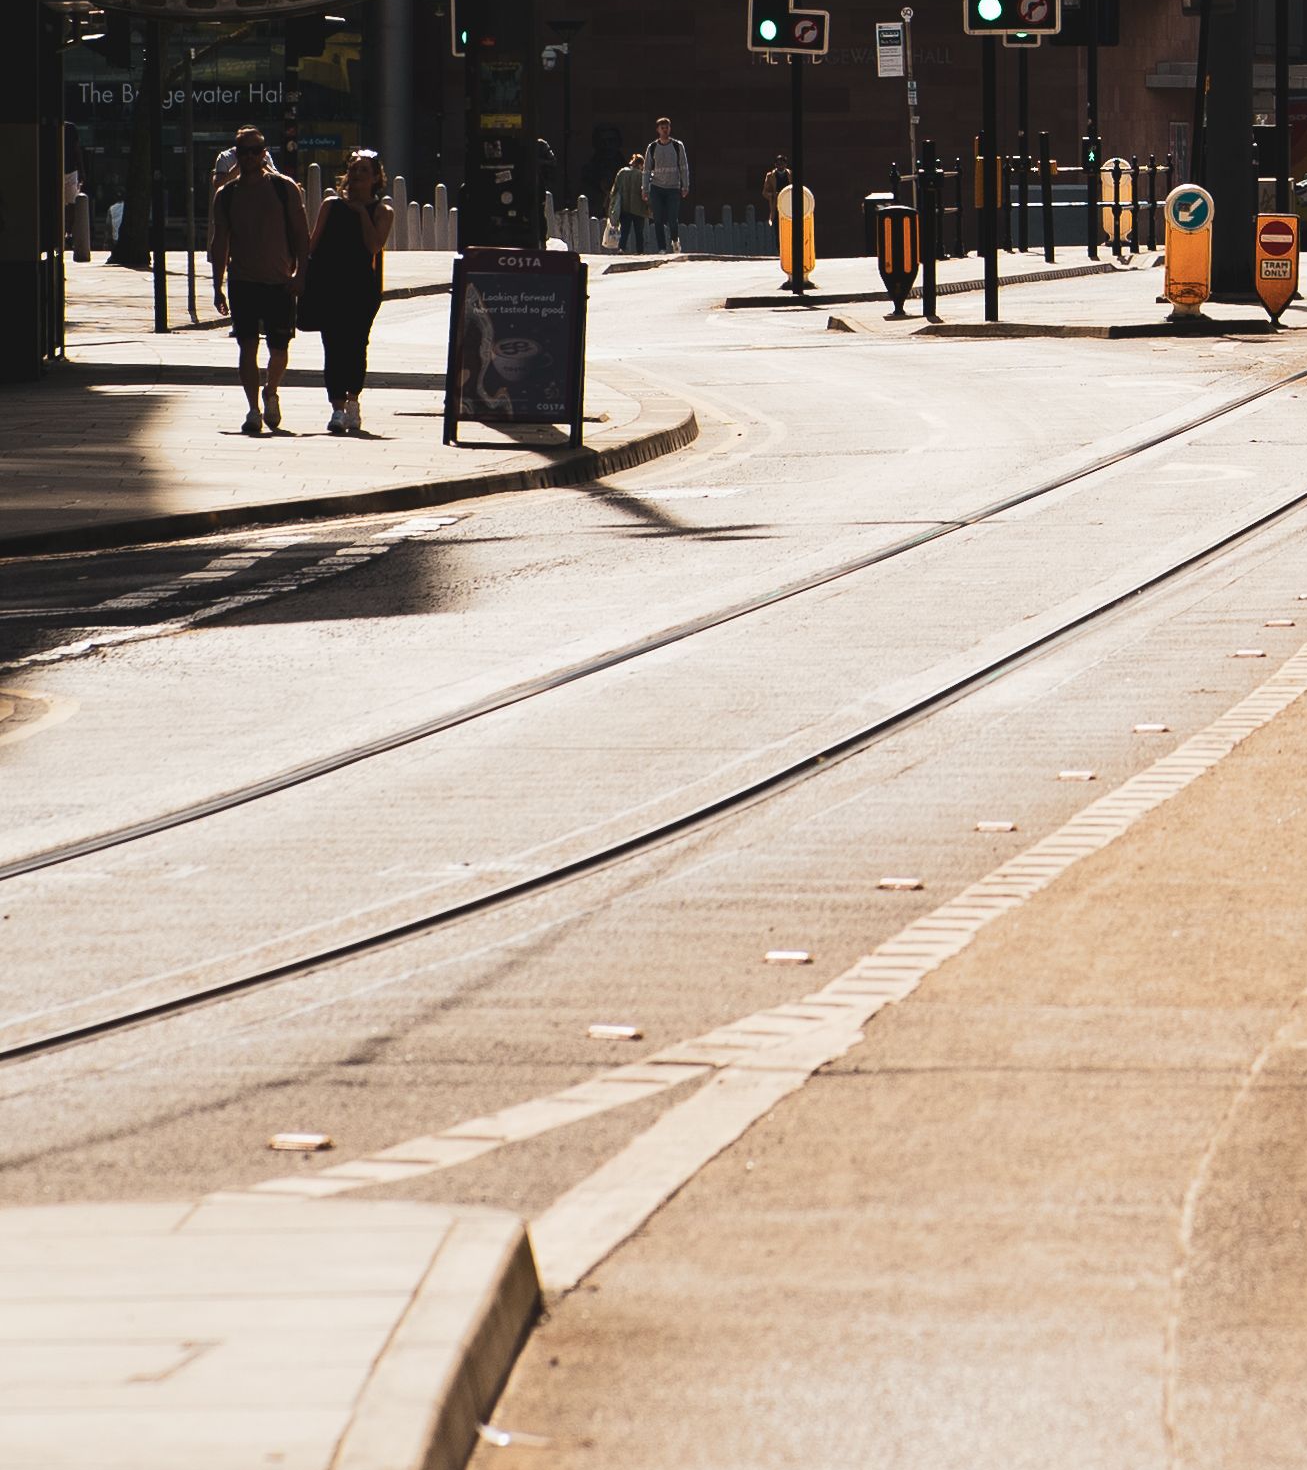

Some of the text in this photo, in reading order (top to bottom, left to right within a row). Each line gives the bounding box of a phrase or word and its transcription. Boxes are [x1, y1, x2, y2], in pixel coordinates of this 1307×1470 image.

[78, 82, 113, 103] The
[498, 256, 542, 268] COSTA
[1264, 269, 1288, 277] ONLY
[482, 292, 556, 305] Looking forward
[499, 306, 528, 314] tasted
[536, 403, 566, 411] COSTA
